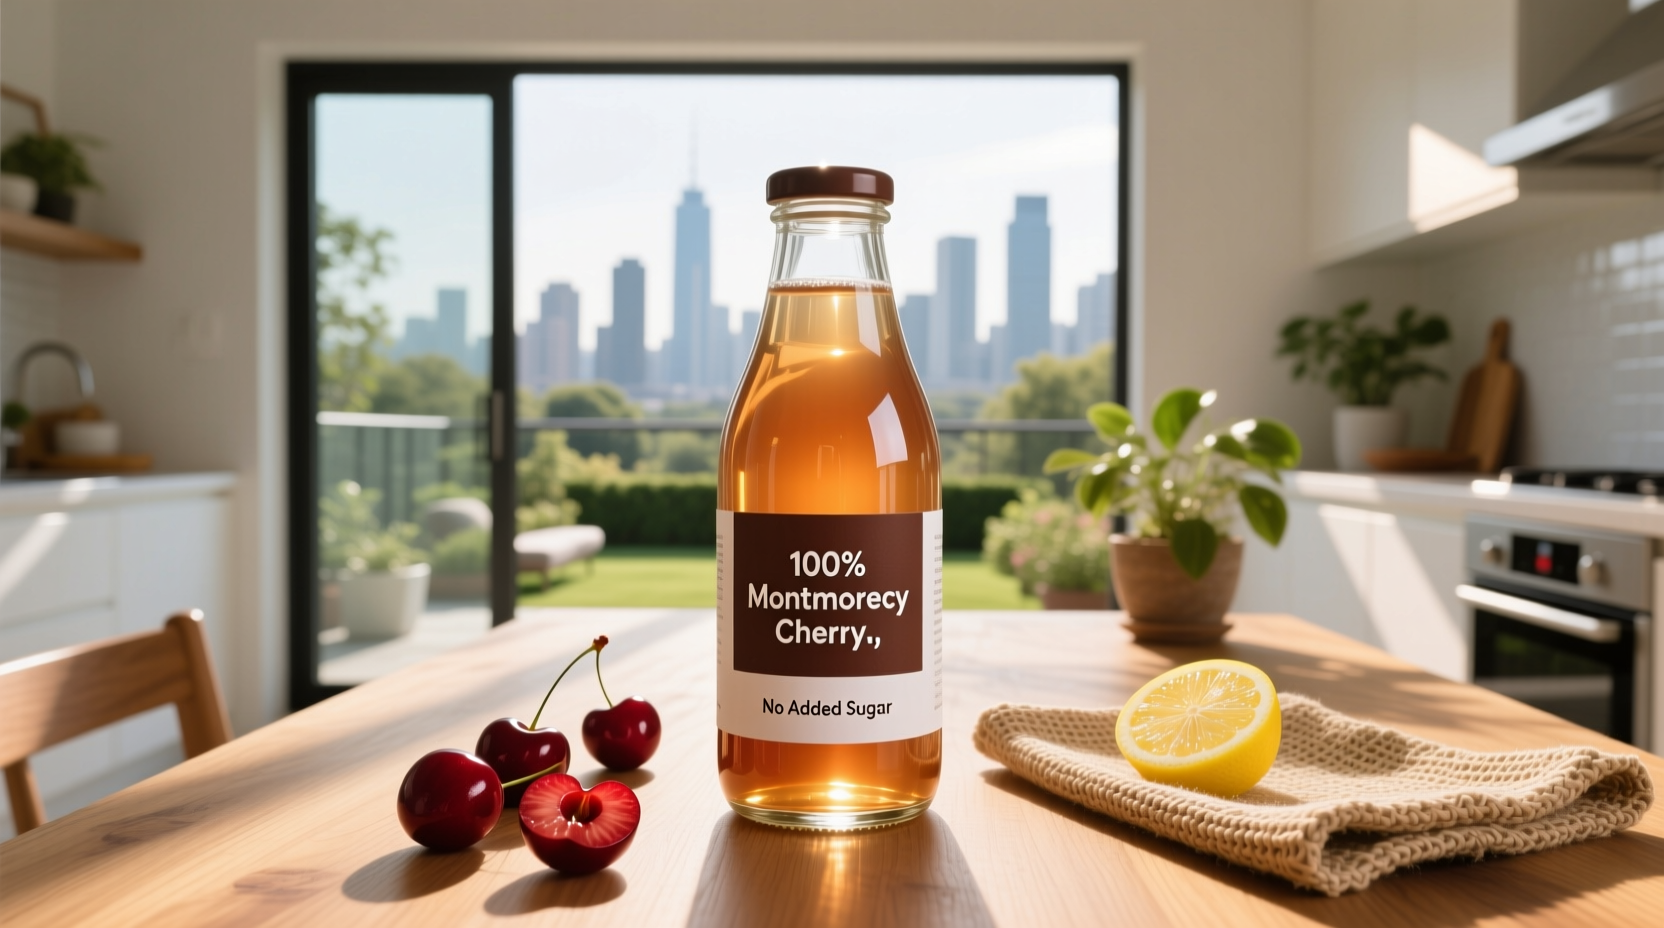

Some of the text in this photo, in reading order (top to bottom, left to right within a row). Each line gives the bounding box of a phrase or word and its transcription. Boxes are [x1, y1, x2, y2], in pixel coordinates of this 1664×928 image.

[789, 550, 866, 578] 100%
[747, 582, 910, 617] Montmorecy
[762, 698, 893, 720] No Added Sugar
